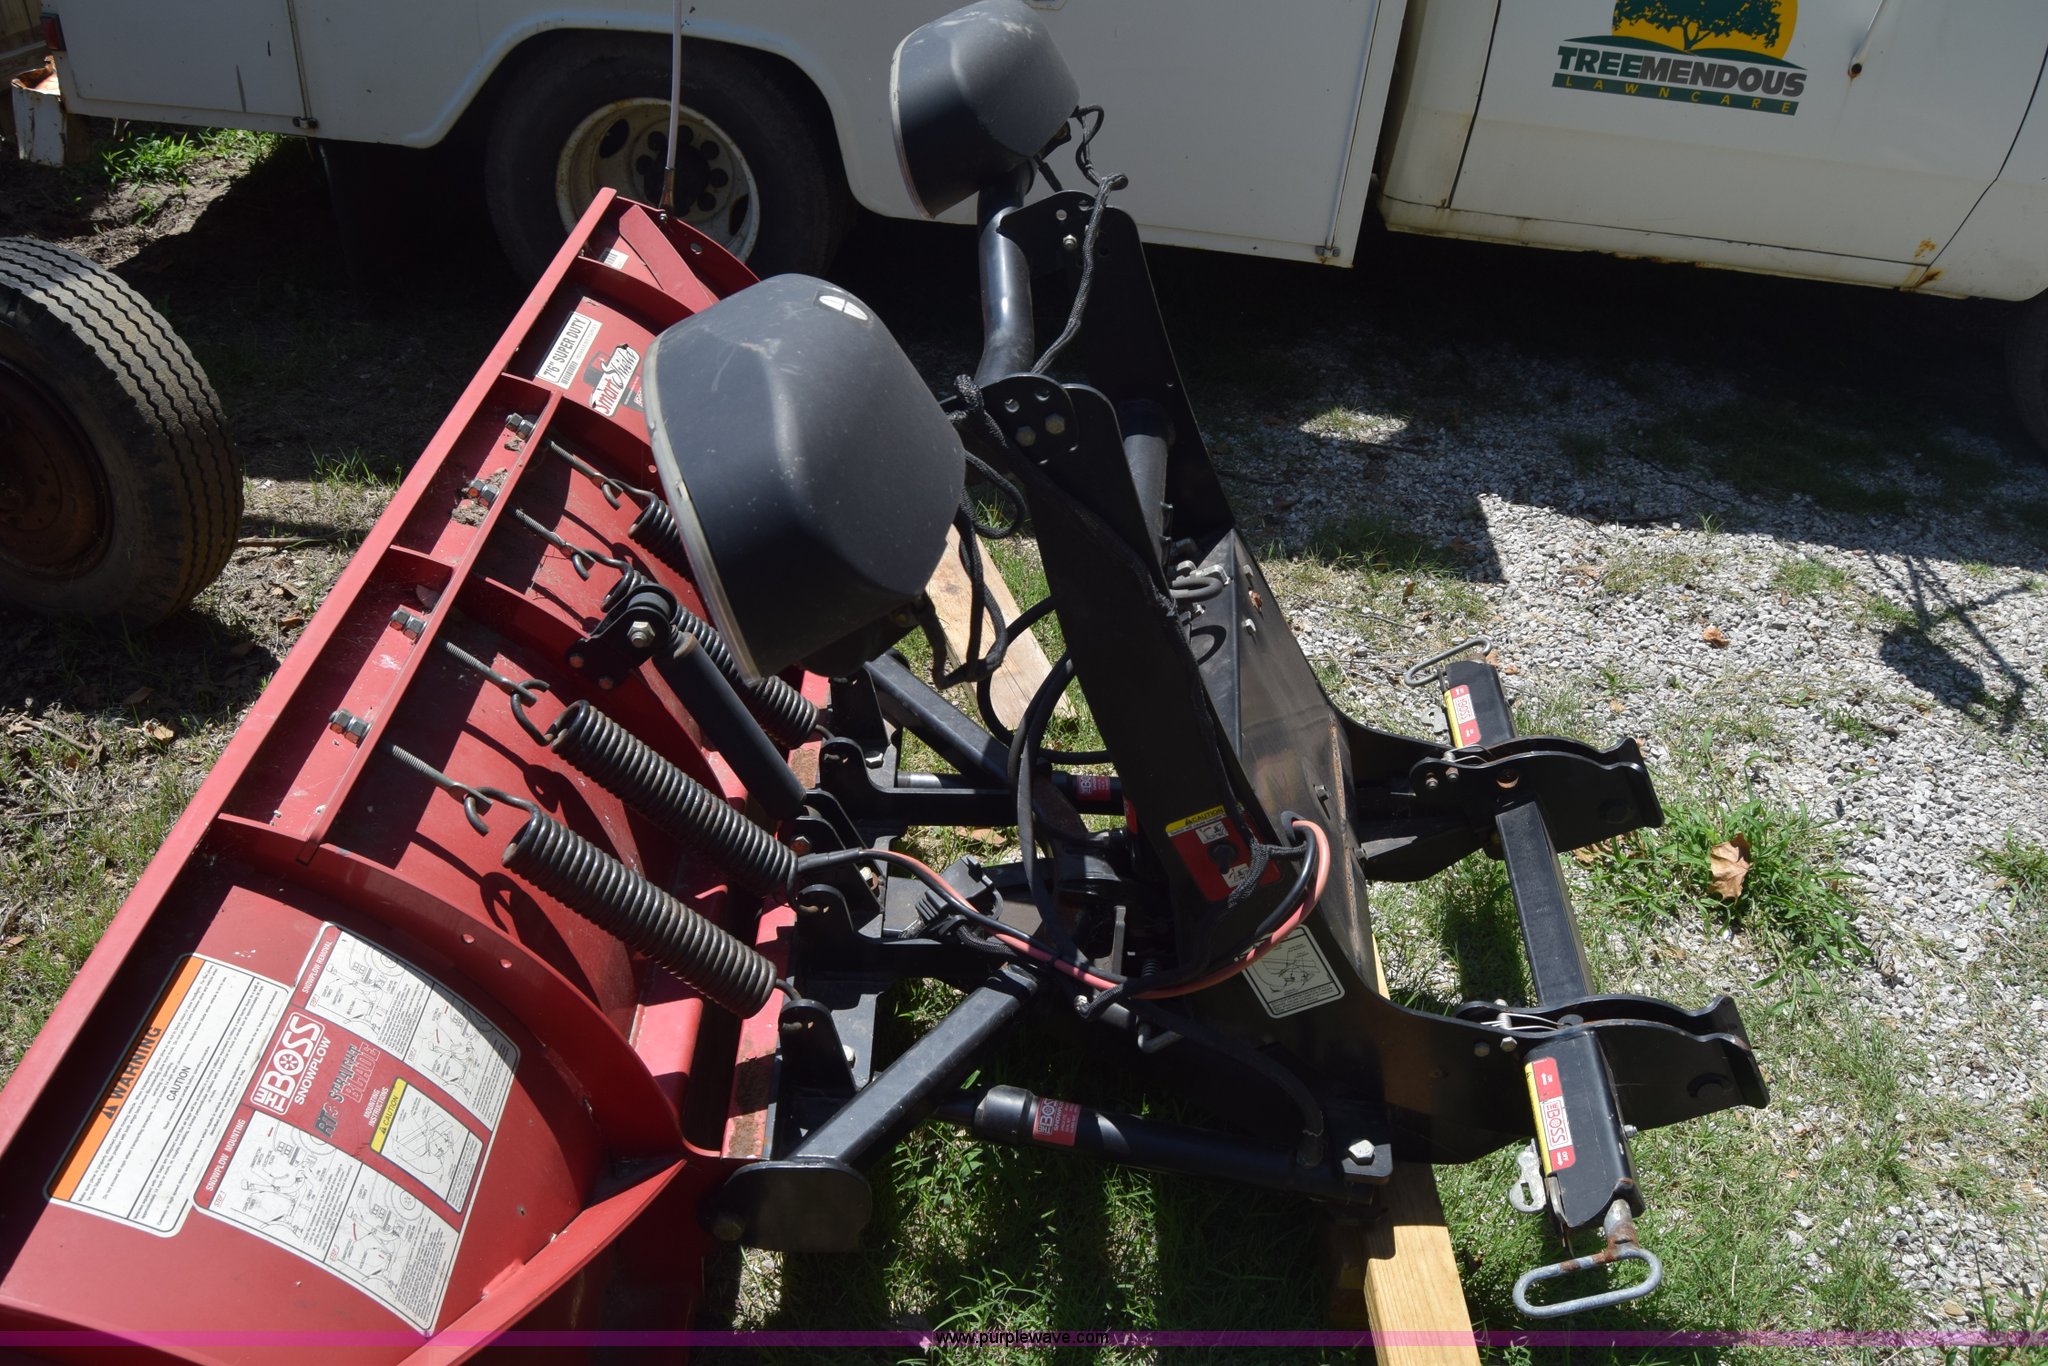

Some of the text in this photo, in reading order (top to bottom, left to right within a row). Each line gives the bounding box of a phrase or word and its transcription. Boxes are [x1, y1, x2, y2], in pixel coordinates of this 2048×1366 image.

[1557, 46, 1807, 97] TREEMENDOUS
[553, 337, 574, 363] SUPER
[566, 317, 586, 339] DUTY
[302, 962, 321, 994] SNOWPLOW
[318, 941, 333, 965] REMOVAL
[110, 1025, 162, 1099] WARNING
[166, 1065, 192, 1101] CAUTION
[253, 1016, 321, 1112] THE BOSS
[294, 1036, 331, 1105] SNOWPLOW
[328, 1044, 363, 1103] STRAIGHT
[341, 1042, 380, 1103] BLADE
[363, 1088, 381, 1119] MOUNTING
[368, 1086, 389, 1128] INSTRUCTIONS
[383, 1095, 398, 1126] CAUTION
[1040, 1098, 1055, 1127] BOS
[1547, 1109, 1566, 1144] BOSS
[206, 1119, 246, 1191] SNOWPLOW MOUNTING
